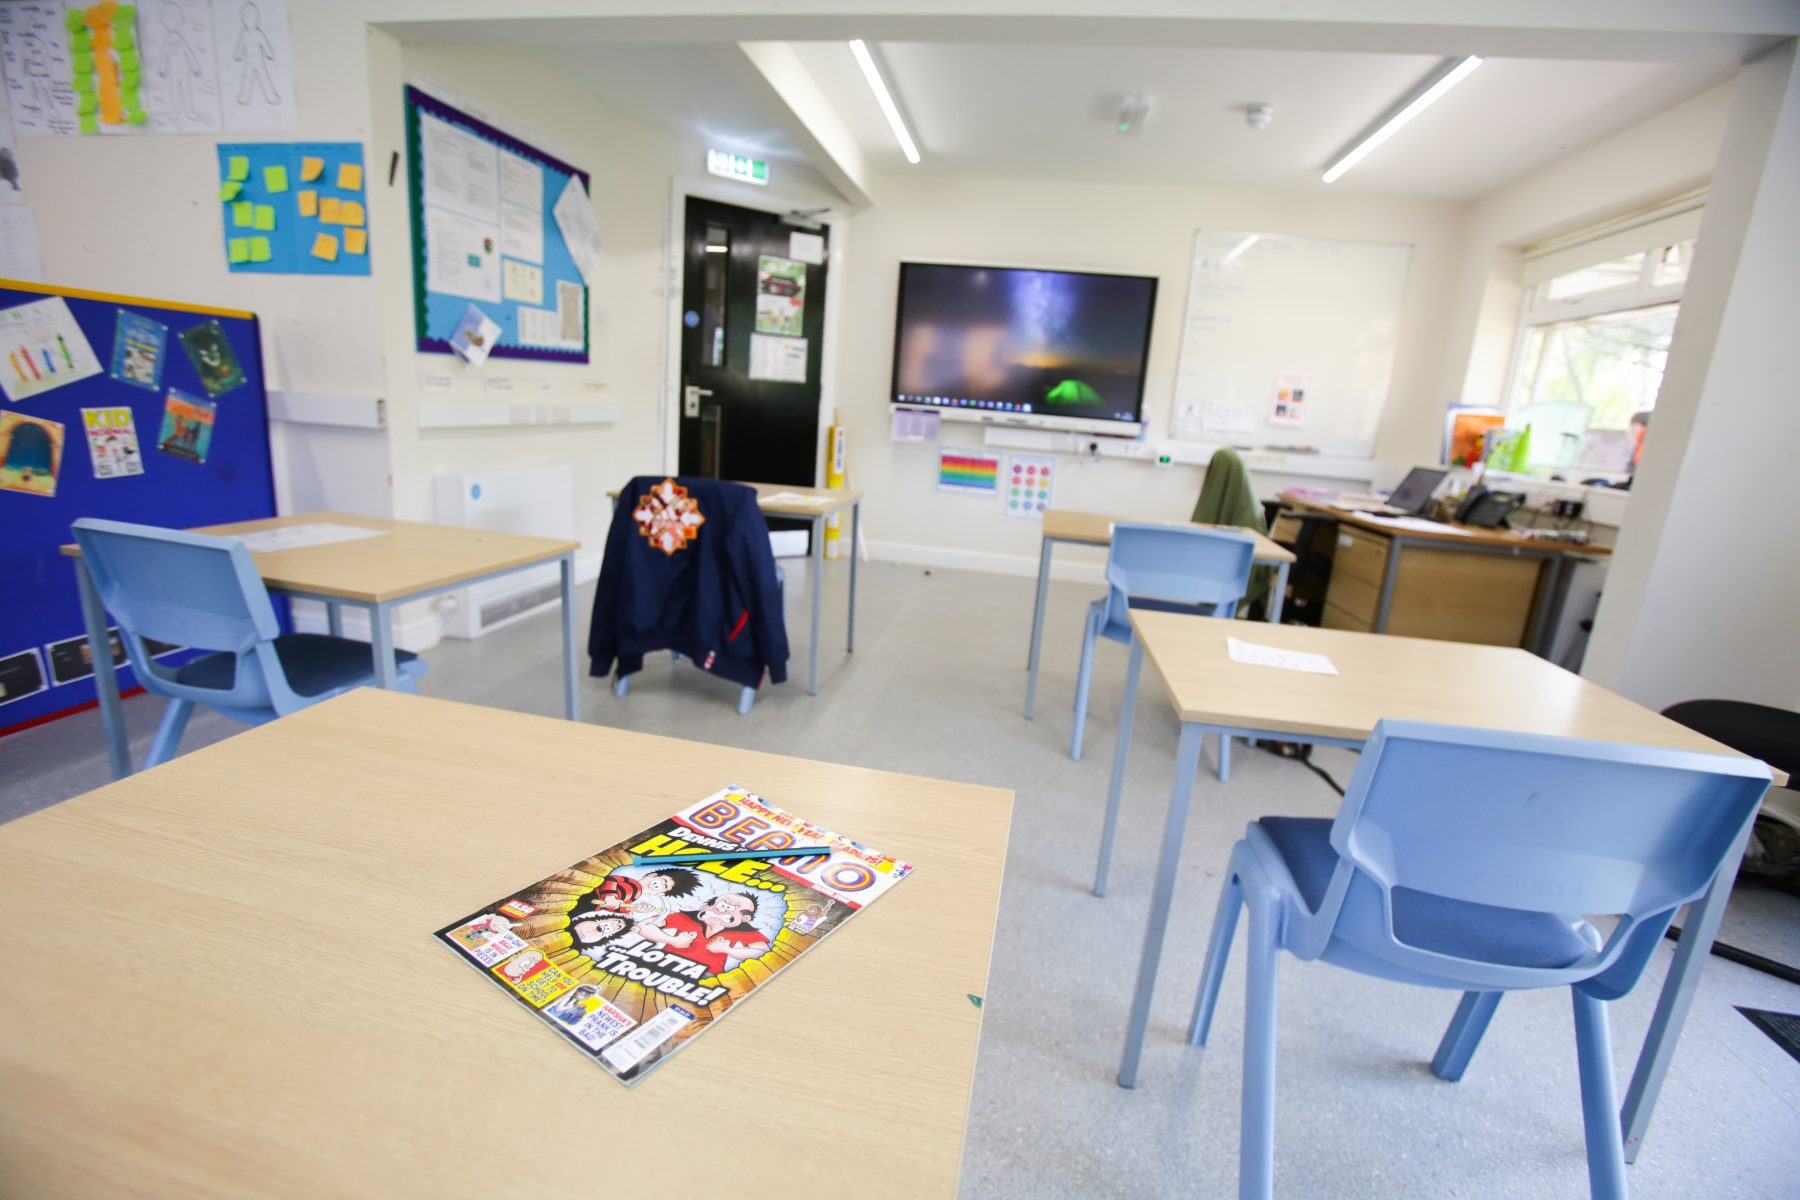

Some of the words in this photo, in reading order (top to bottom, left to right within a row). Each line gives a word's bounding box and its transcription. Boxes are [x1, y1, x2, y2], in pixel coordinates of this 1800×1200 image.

[85, 409, 130, 429] KID
[738, 797, 775, 818] HAPPY
[667, 826, 738, 851] DENNIS
[689, 799, 877, 893] BEANO
[506, 900, 536, 914] ALSO
[608, 940, 708, 980] ...LOTTA
[541, 970, 558, 983] HELP
[548, 967, 562, 978] CAN
[561, 976, 575, 986] YOU
[596, 951, 728, 1006] TROUBLE!
[527, 981, 549, 999] SCHOOL
[586, 1014, 610, 1033] PRANK
[608, 1029, 618, 1037] IS
[597, 1009, 625, 1030] NEWEST
[578, 1029, 597, 1042] BAG!
[583, 1022, 594, 1030] IN
[591, 1026, 608, 1039] THE
